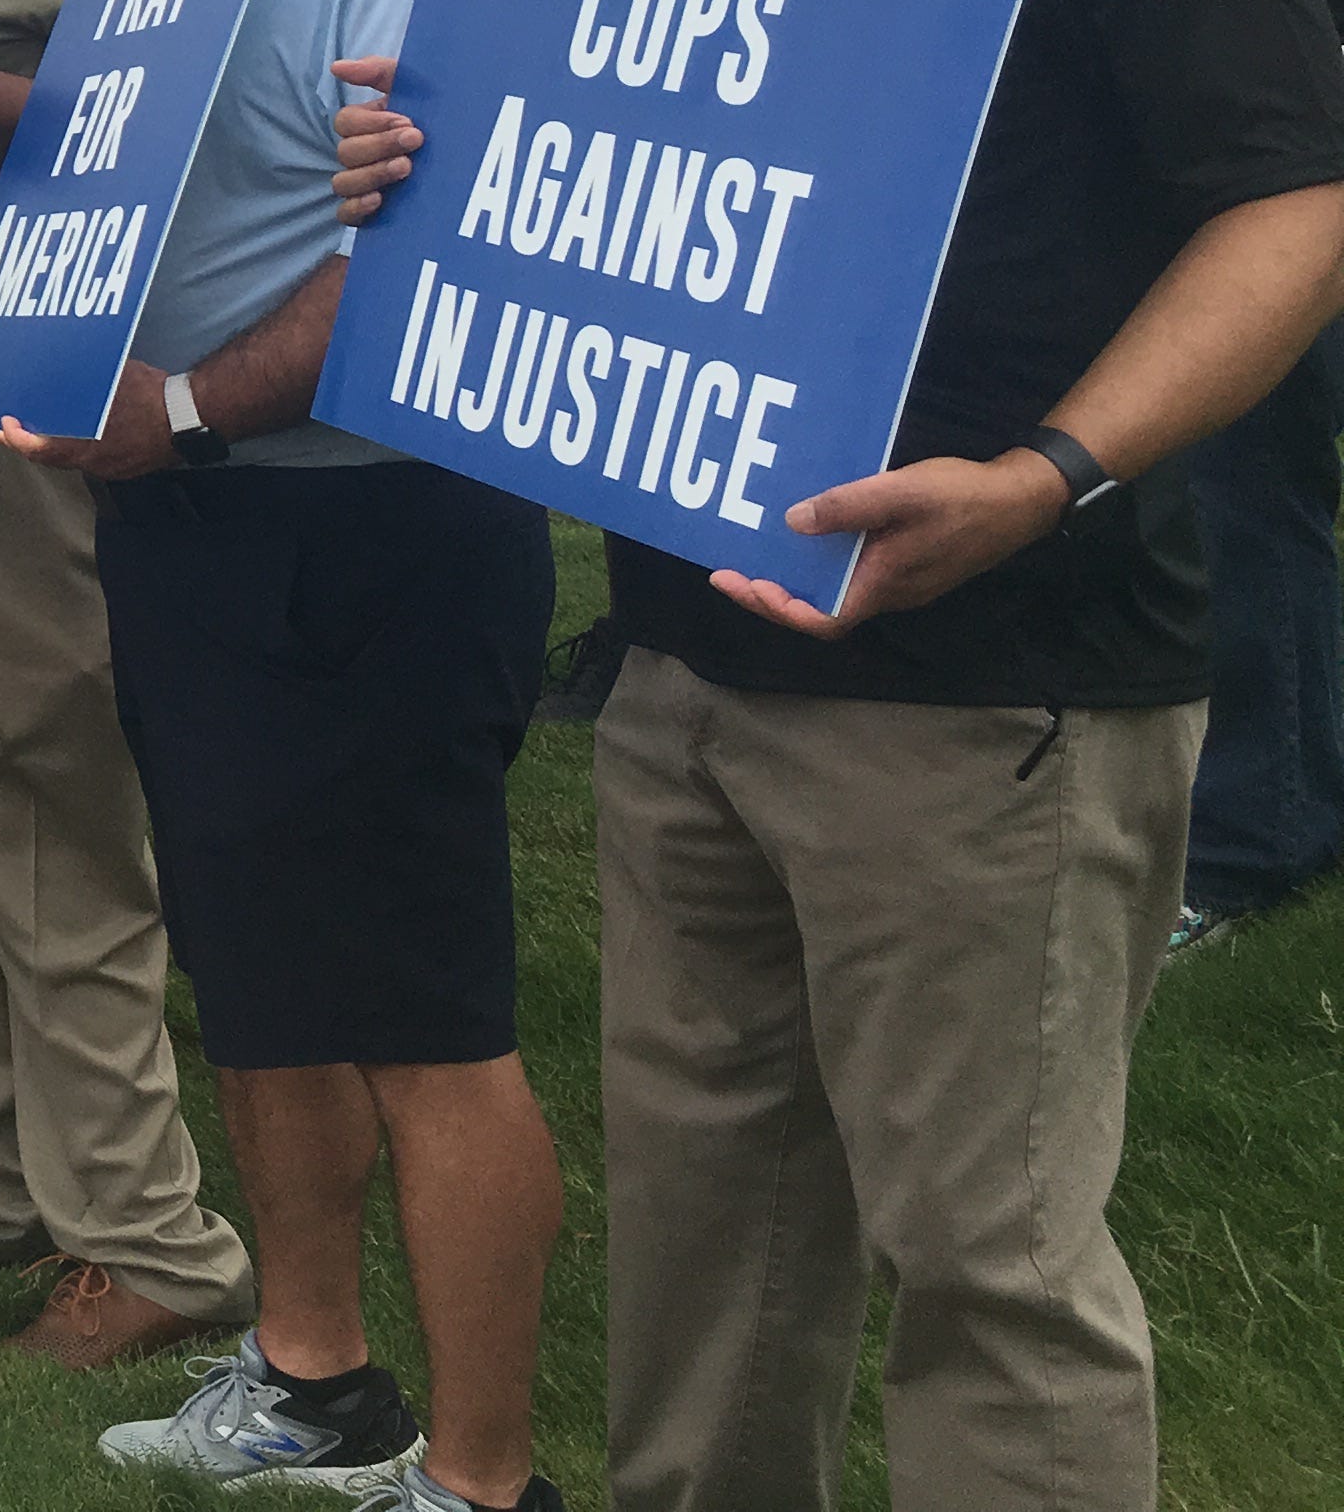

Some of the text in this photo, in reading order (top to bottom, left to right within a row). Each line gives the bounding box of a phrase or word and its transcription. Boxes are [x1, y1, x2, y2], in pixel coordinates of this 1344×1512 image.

[50, 65, 145, 178] FOR
[458, 95, 814, 316] AGAINST
[389, 257, 798, 531] INJUSTICE
